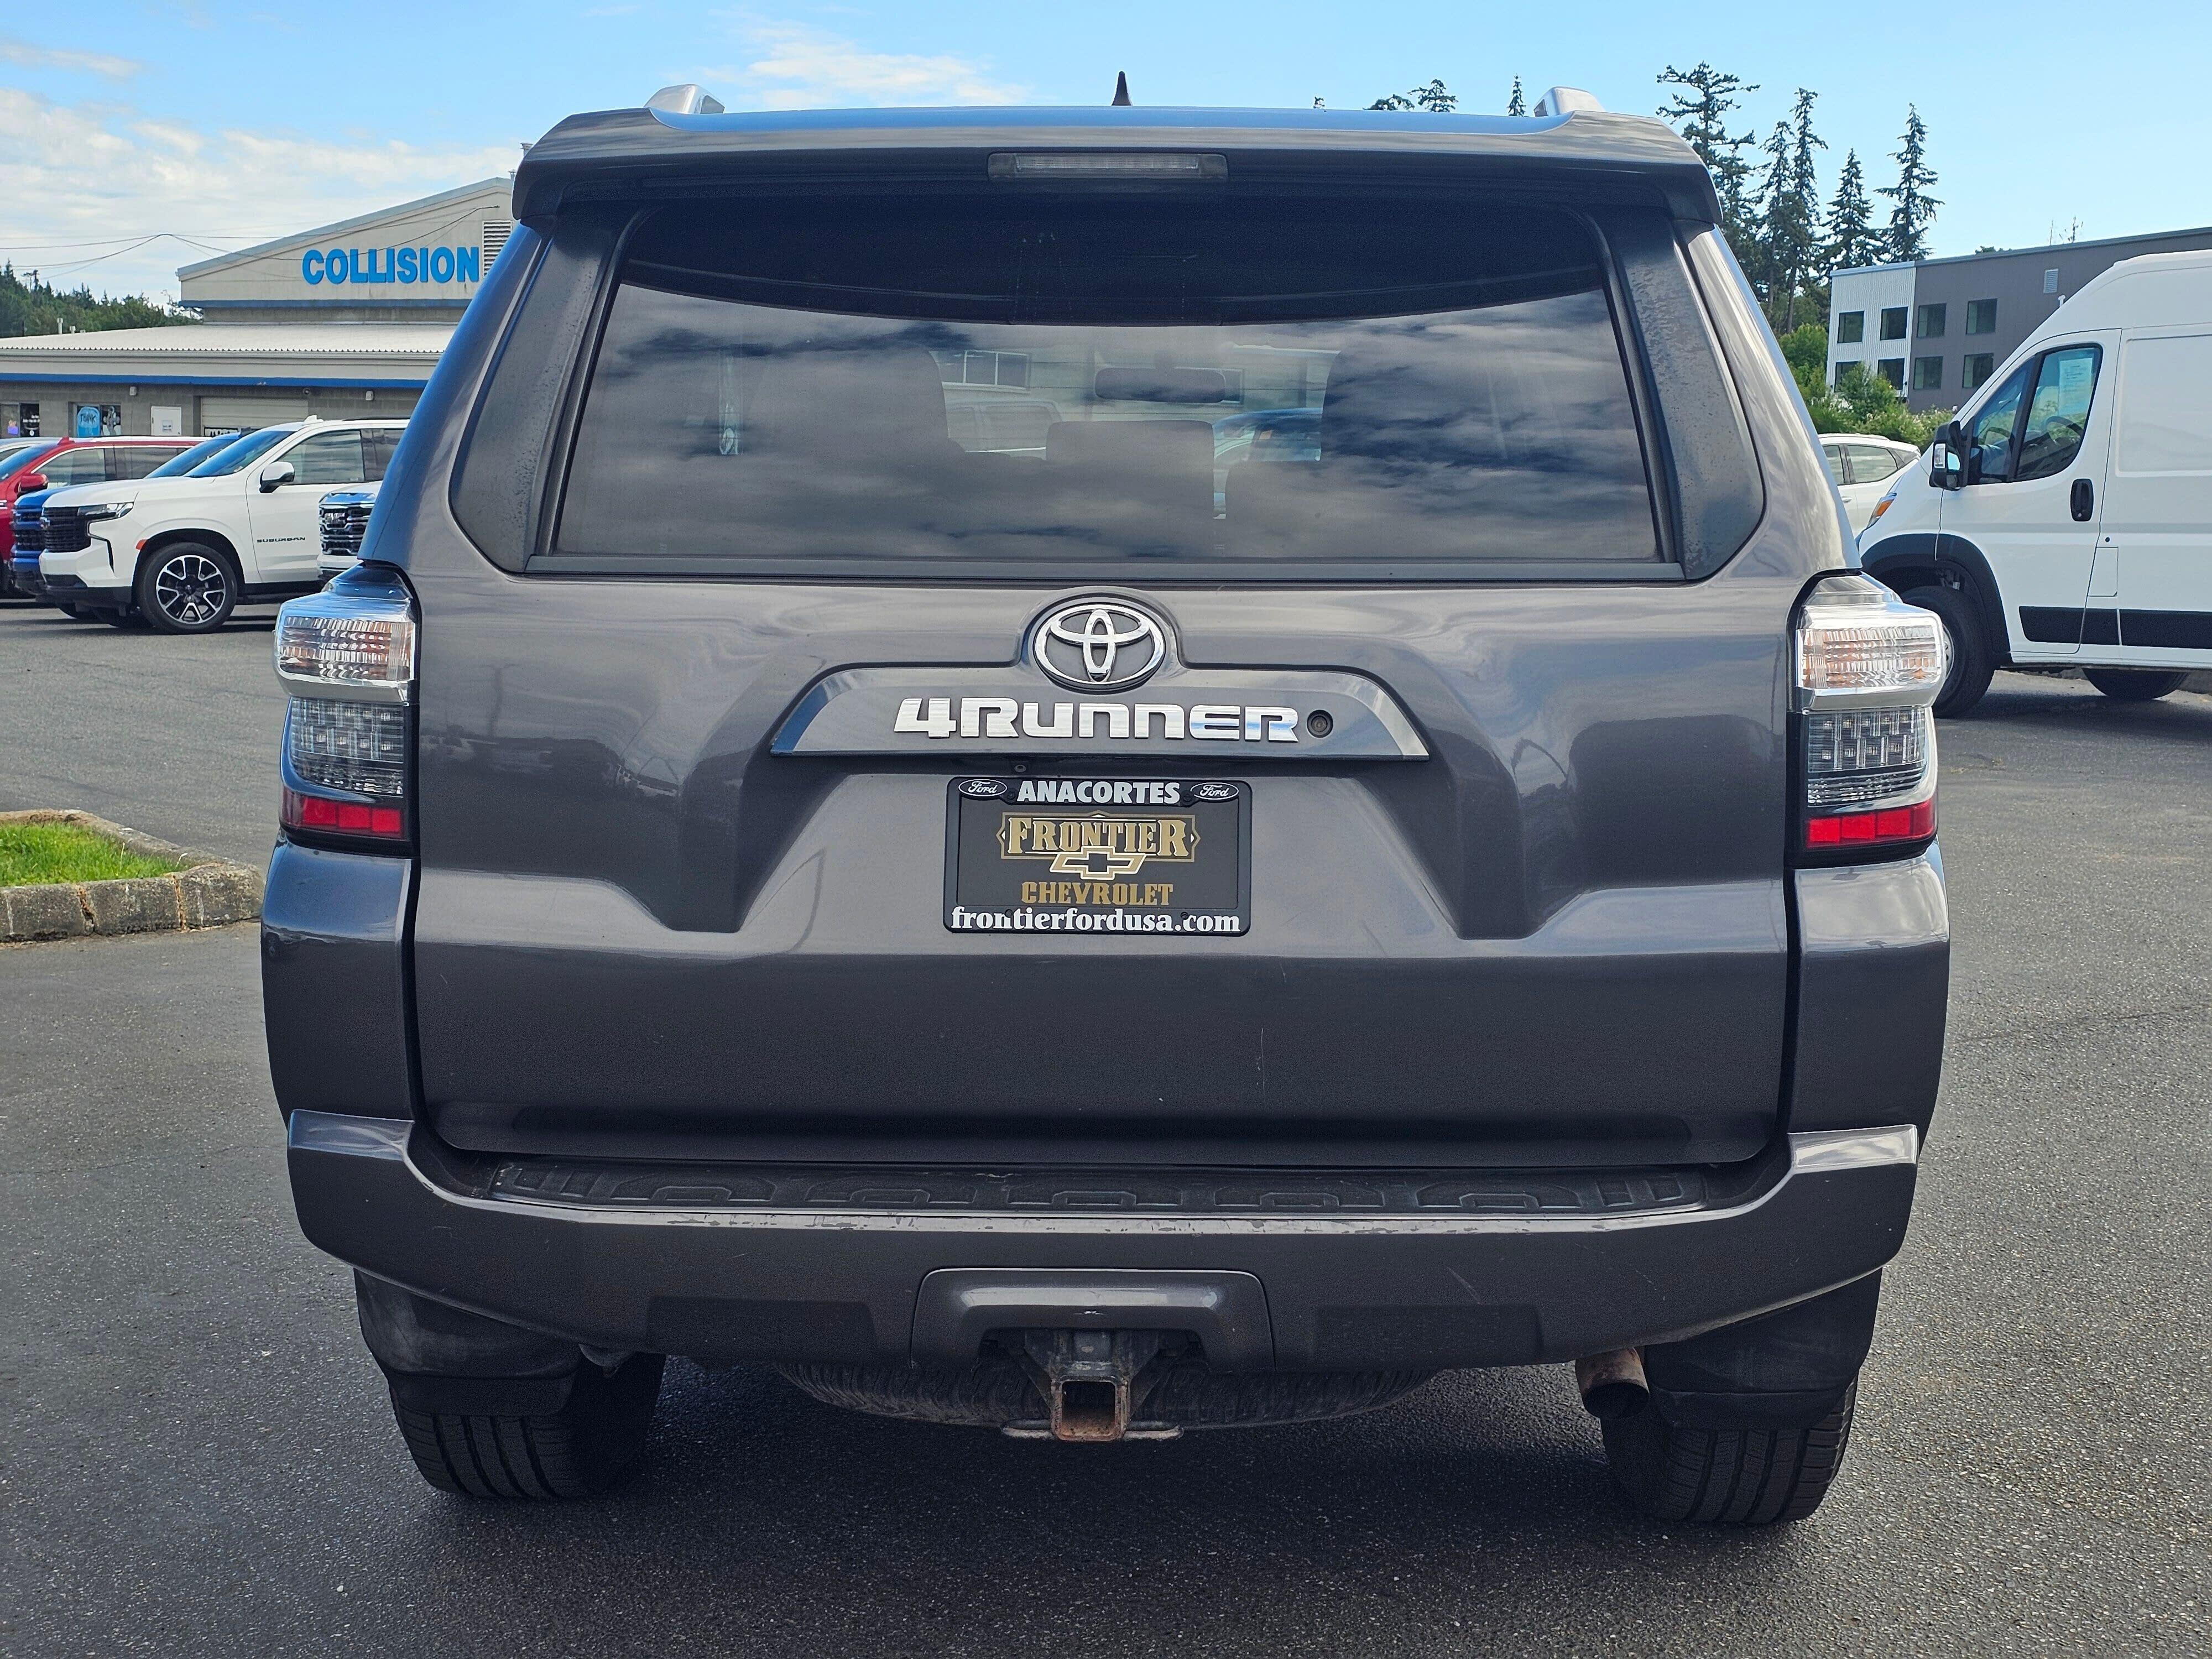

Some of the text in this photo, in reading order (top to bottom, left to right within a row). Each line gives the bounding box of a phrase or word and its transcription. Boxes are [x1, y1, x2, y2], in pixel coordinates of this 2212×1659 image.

[302, 247, 479, 285] COLLISION
[1016, 781, 1181, 804] ANACORTES
[1006, 817, 1190, 857] FRONTIER
[1021, 882, 1173, 906] CHEVROLET
[952, 906, 1241, 932] frontierfordusa.com
